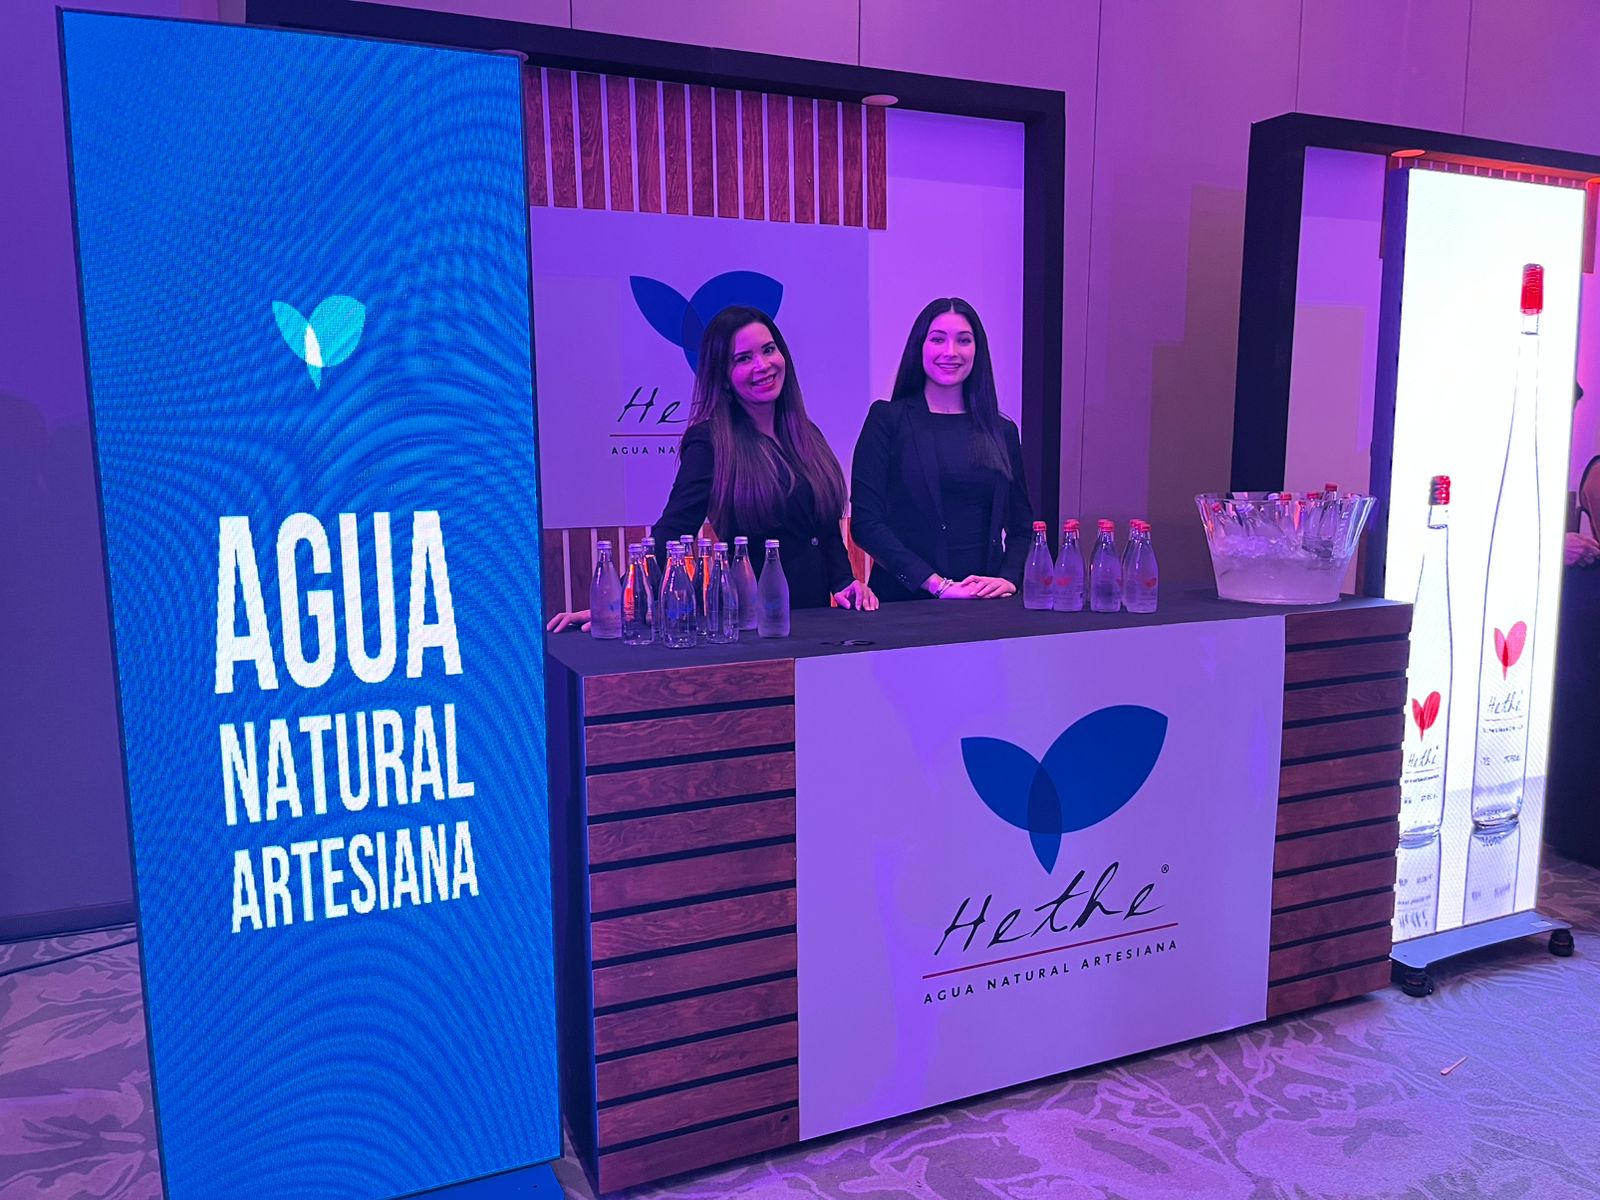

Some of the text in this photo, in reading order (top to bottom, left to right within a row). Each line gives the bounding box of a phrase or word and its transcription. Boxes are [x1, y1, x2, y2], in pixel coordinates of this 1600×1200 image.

[611, 446, 649, 455] AGUA
[214, 510, 463, 694] AGUA
[219, 703, 475, 826] NATURAL
[231, 820, 479, 933] ARTESIANA
[934, 861, 1166, 956] Hethe
[923, 939, 1178, 1004] AGUA NATURAL ARTESIANA
